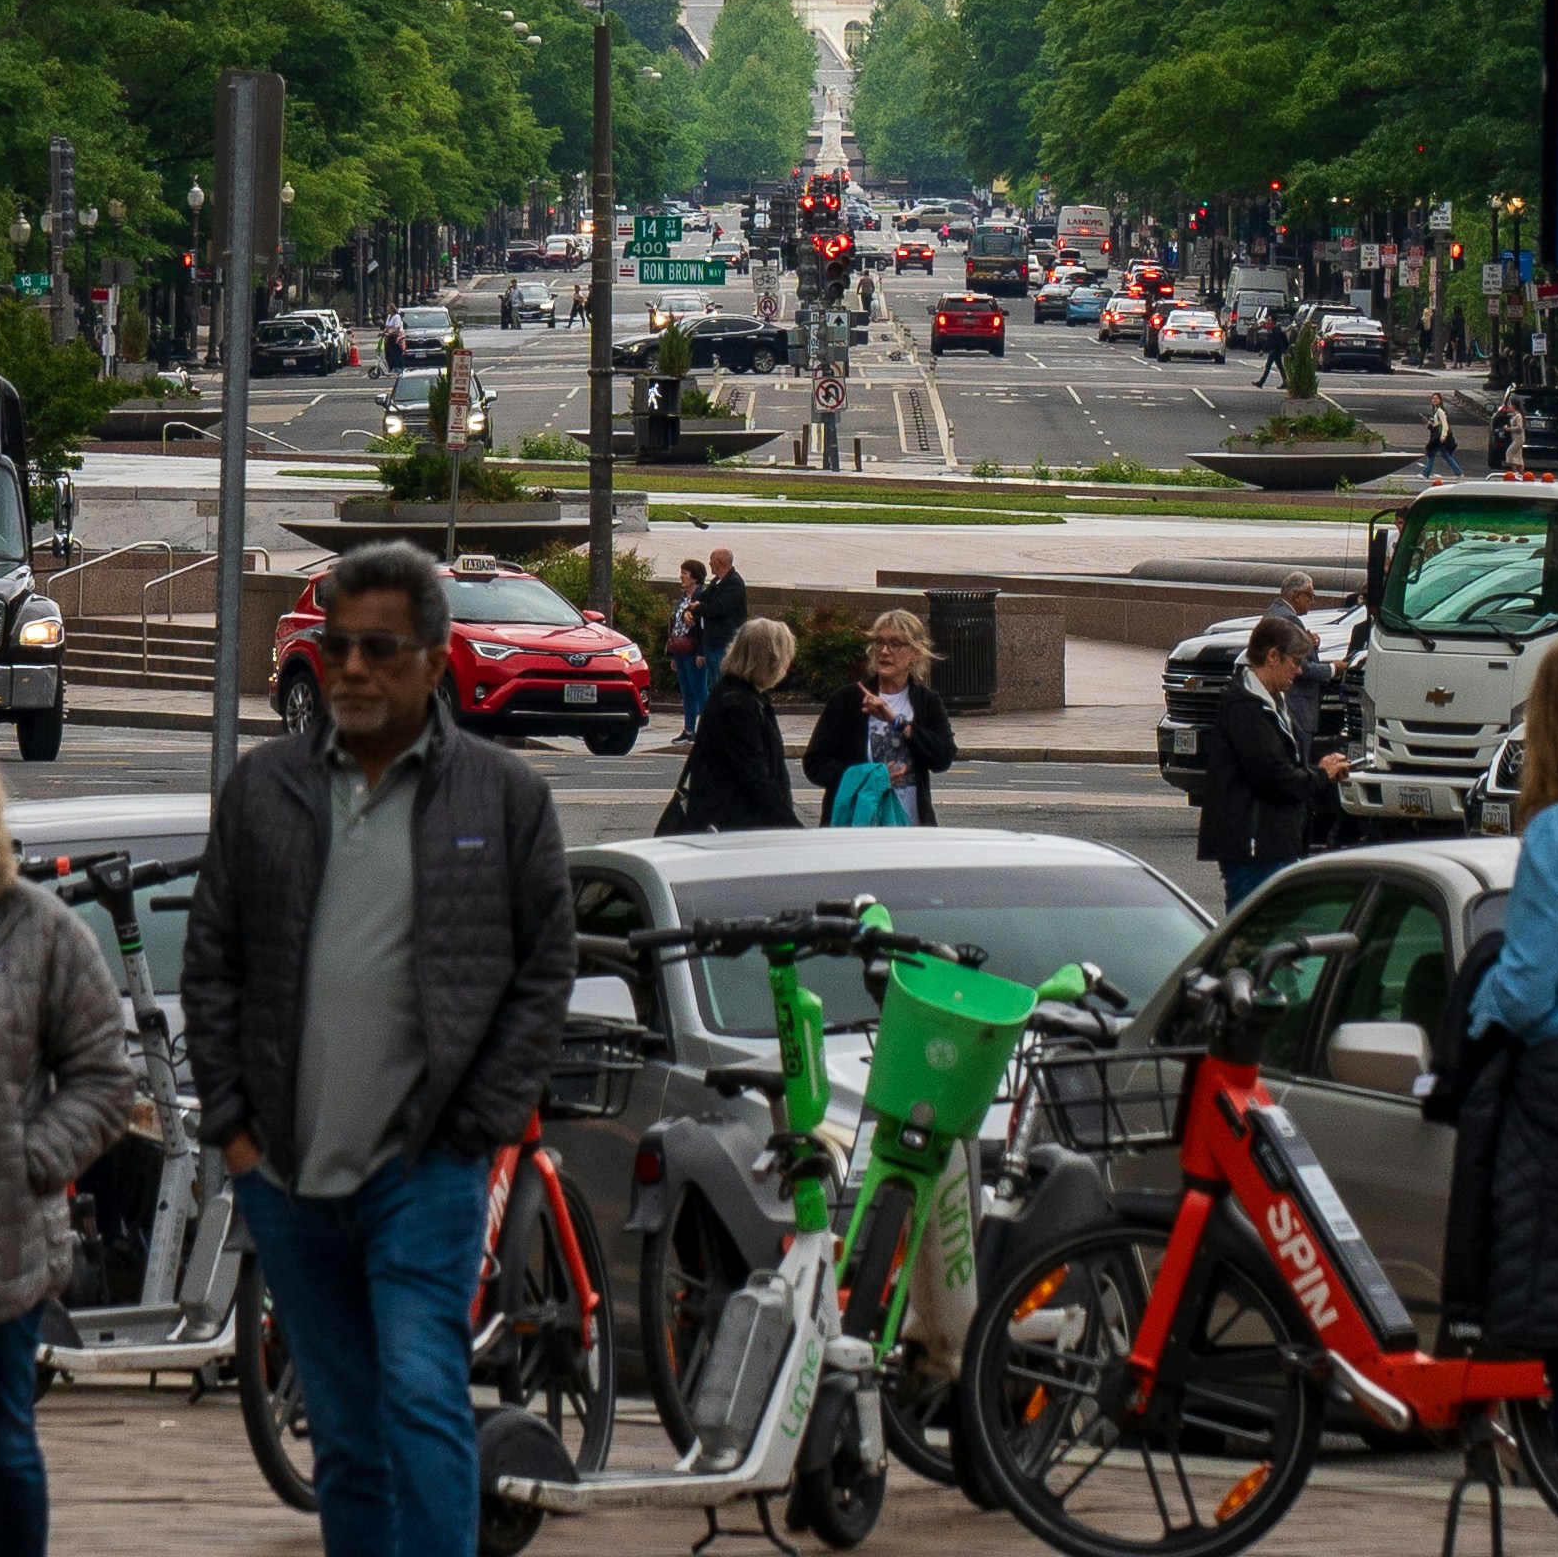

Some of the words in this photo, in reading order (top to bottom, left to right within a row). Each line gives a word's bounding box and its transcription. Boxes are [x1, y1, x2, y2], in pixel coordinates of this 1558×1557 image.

[642, 220, 657, 237] 14
[666, 220, 676, 229] ST
[664, 229, 677, 238] NW
[632, 242, 663, 254] 400
[643, 263, 663, 280] RON
[669, 263, 704, 280] BROWN
[709, 268, 721, 277] WAY
[20, 276, 31, 286] 13
[463, 558, 480, 570] TAXI
[1266, 1198, 1340, 1331] SPIN
[780, 1338, 822, 1440] Lime
